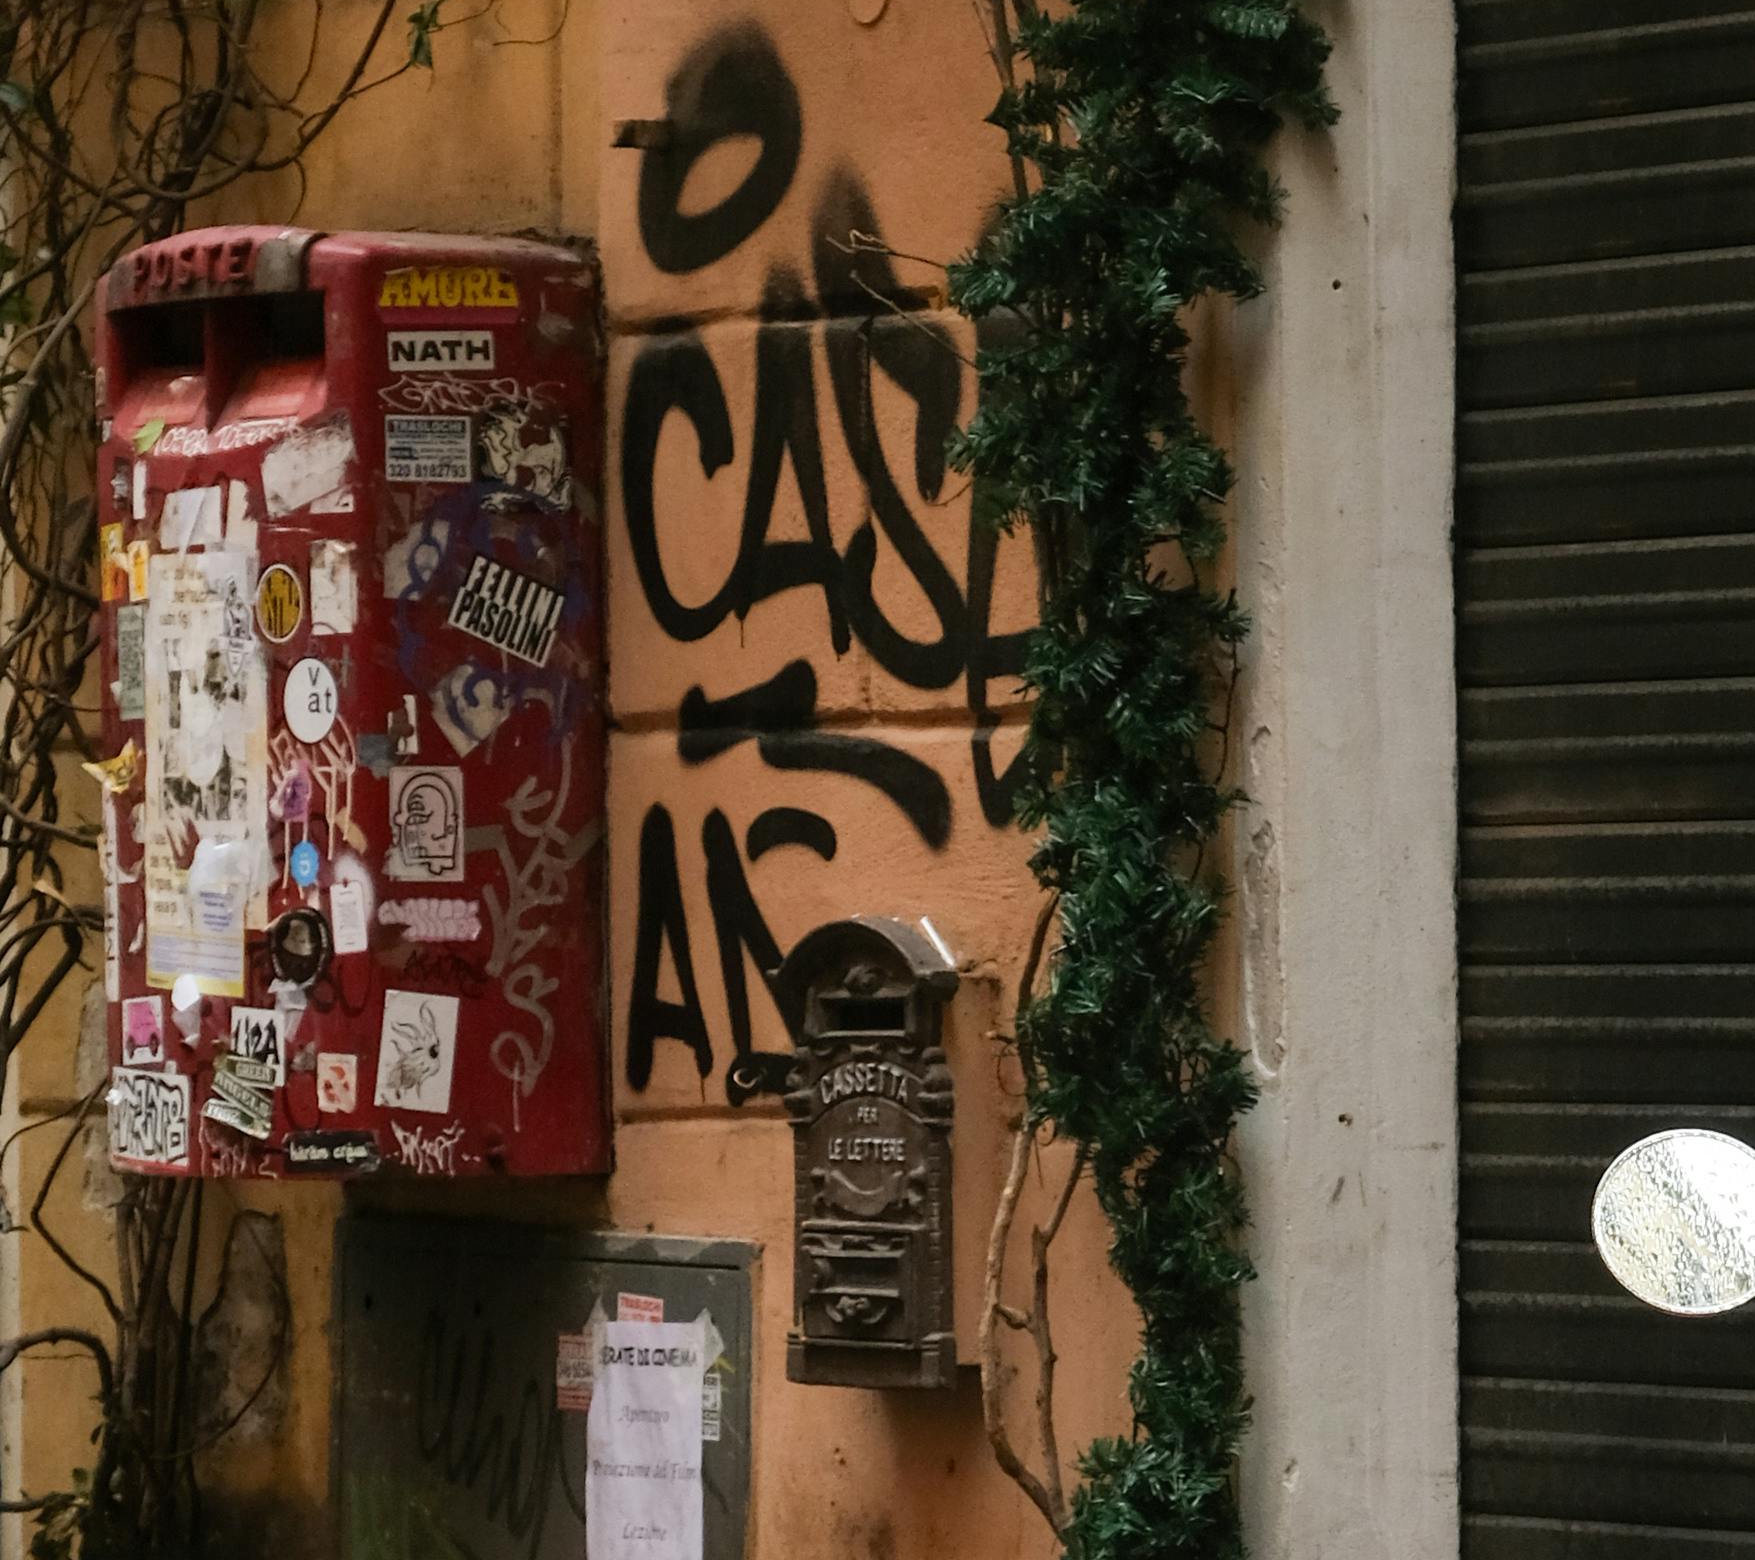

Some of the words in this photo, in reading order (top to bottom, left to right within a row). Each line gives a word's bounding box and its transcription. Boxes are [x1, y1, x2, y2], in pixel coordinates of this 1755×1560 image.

[133, 238, 255, 298] POSTE
[391, 340, 490, 362] NATH
[464, 555, 566, 631] FELLINI
[453, 587, 558, 665] PASOLINI
[820, 1061, 908, 1105] CASSETTA
[857, 1106, 878, 1124] PER
[828, 1138, 842, 1160] LE
[847, 1138, 905, 1161] LETTERE
